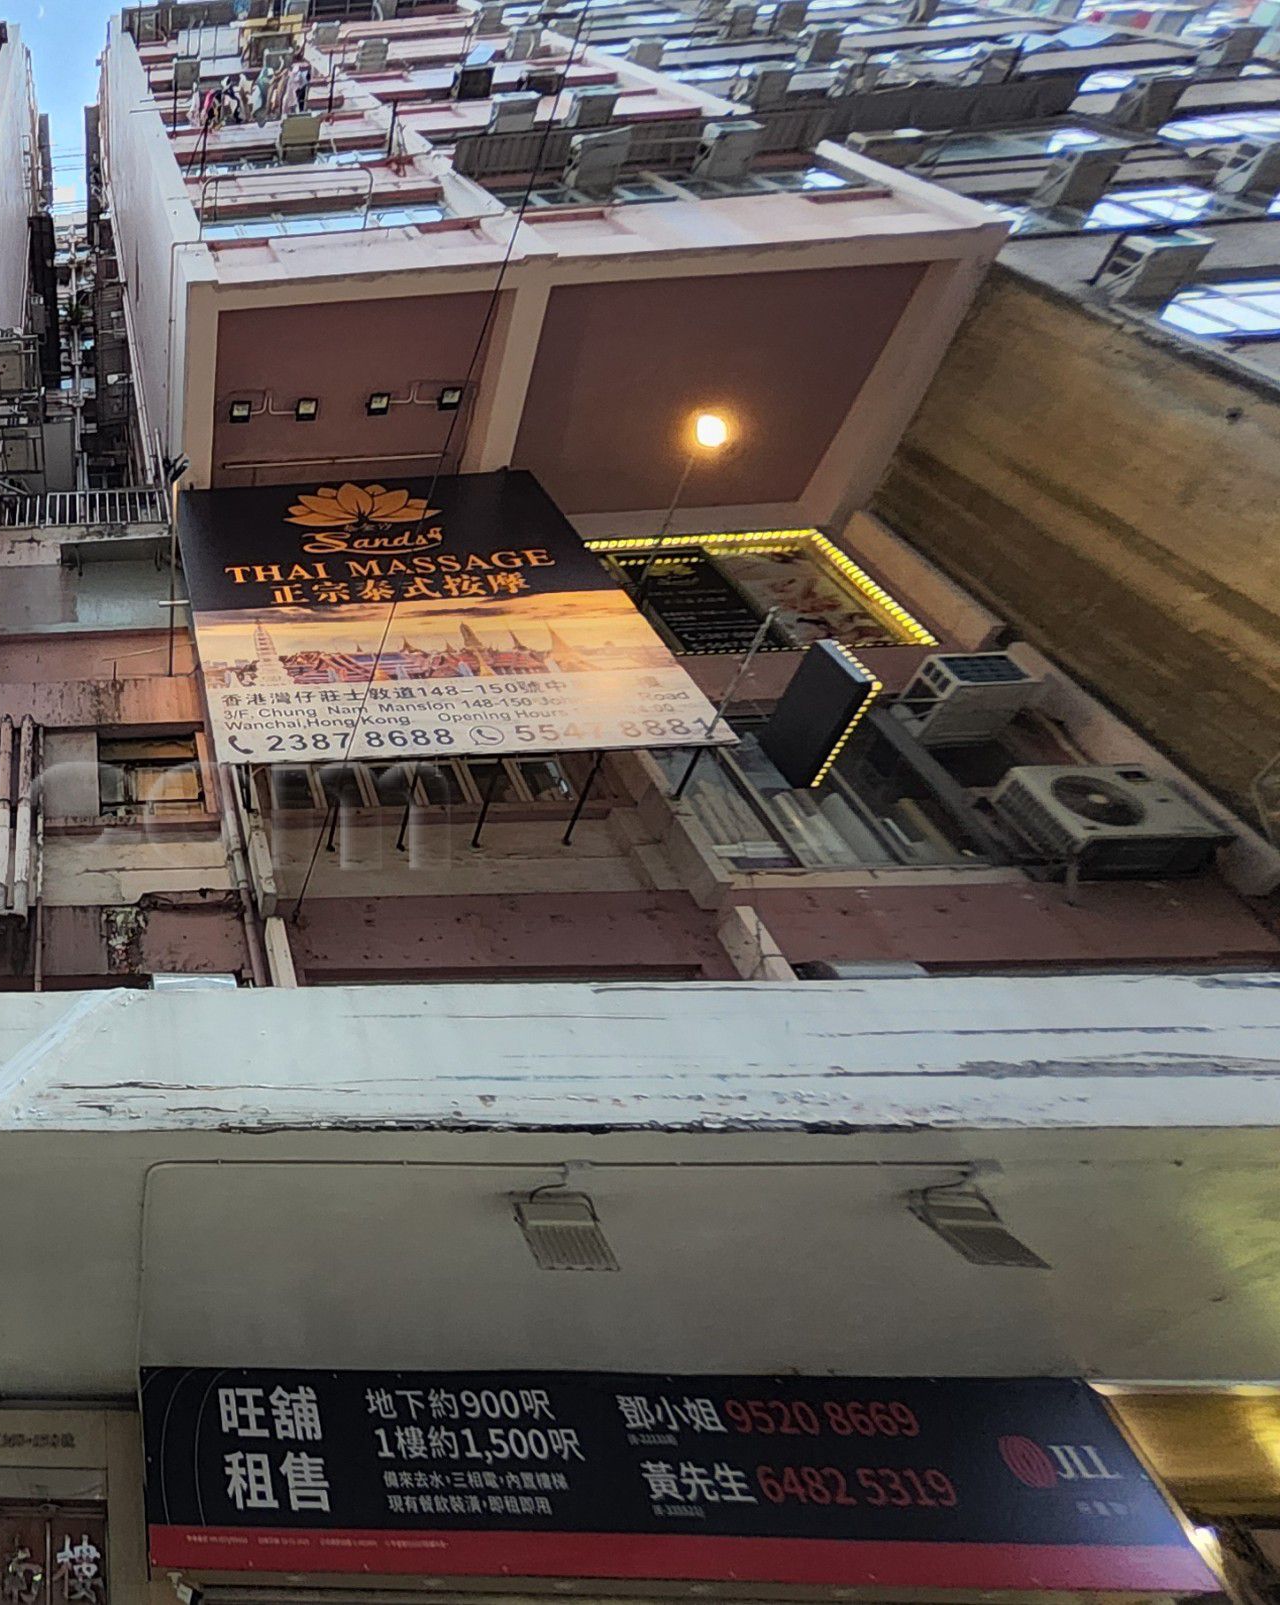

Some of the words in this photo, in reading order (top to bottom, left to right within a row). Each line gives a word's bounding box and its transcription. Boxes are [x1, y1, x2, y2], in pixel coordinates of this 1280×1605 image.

[225, 563, 331, 583] THAI
[346, 548, 556, 577] MASSAGE
[270, 571, 531, 604] 正宗泰式按摩
[259, 706, 317, 719] Chung
[328, 703, 369, 715] Nam
[378, 700, 456, 713] Mansion
[462, 696, 533, 708] 148-150
[438, 711, 511, 723] Opening
[266, 732, 351, 752] 2387
[365, 728, 455, 748] 8688
[365, 1387, 556, 1422] 地下約900呎
[615, 1395, 728, 1434] 鄧小姐
[724, 1400, 821, 1436] 9520
[823, 1401, 921, 1438] 8669
[374, 1425, 586, 1465] 1樓約1,500呎
[1047, 1444, 1127, 1482] JLL
[224, 1450, 331, 1513] 租售
[640, 1461, 759, 1504] 黃先生
[755, 1464, 858, 1504] 6482
[855, 1467, 958, 1507] 5319
